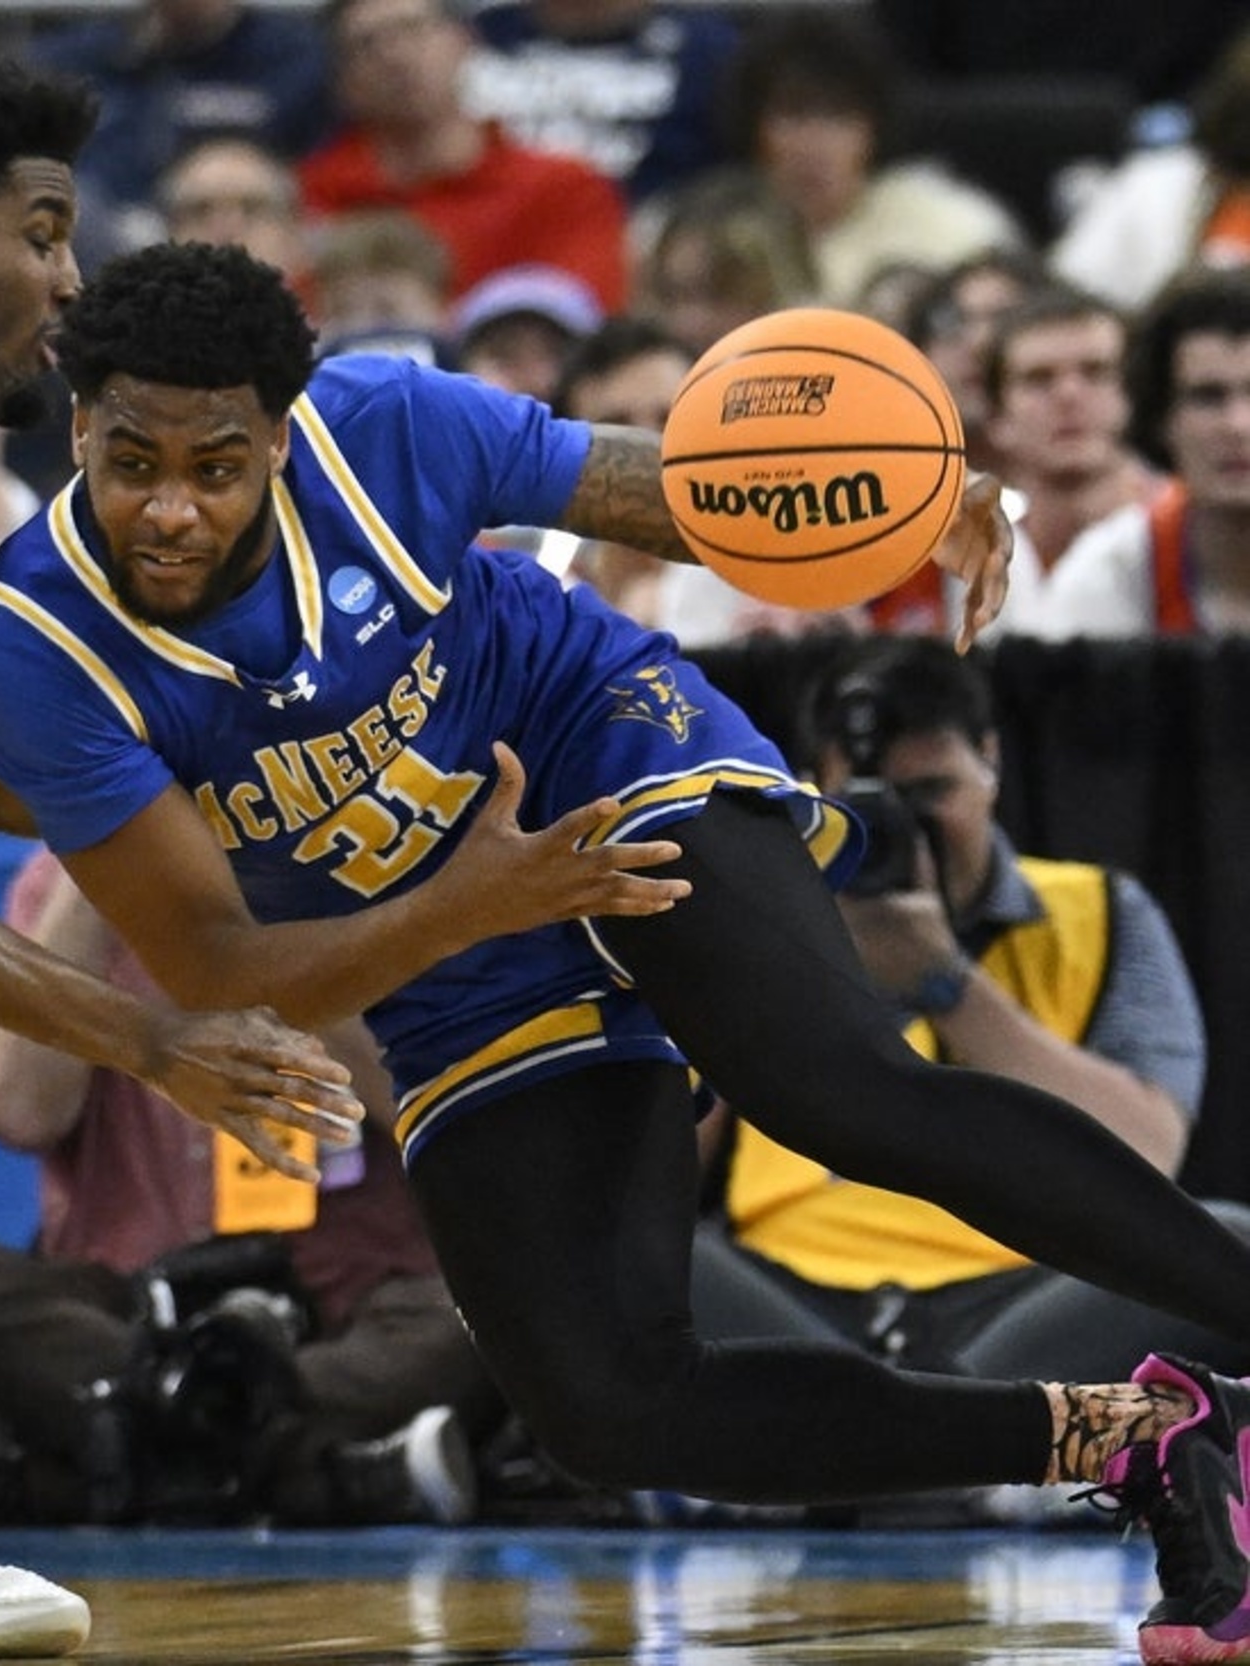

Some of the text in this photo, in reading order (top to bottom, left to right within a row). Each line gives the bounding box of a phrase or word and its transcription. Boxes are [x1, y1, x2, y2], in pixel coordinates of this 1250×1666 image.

[688, 470, 890, 533] Wilson
[355, 603, 396, 646] SLC
[292, 745, 487, 898] 21
